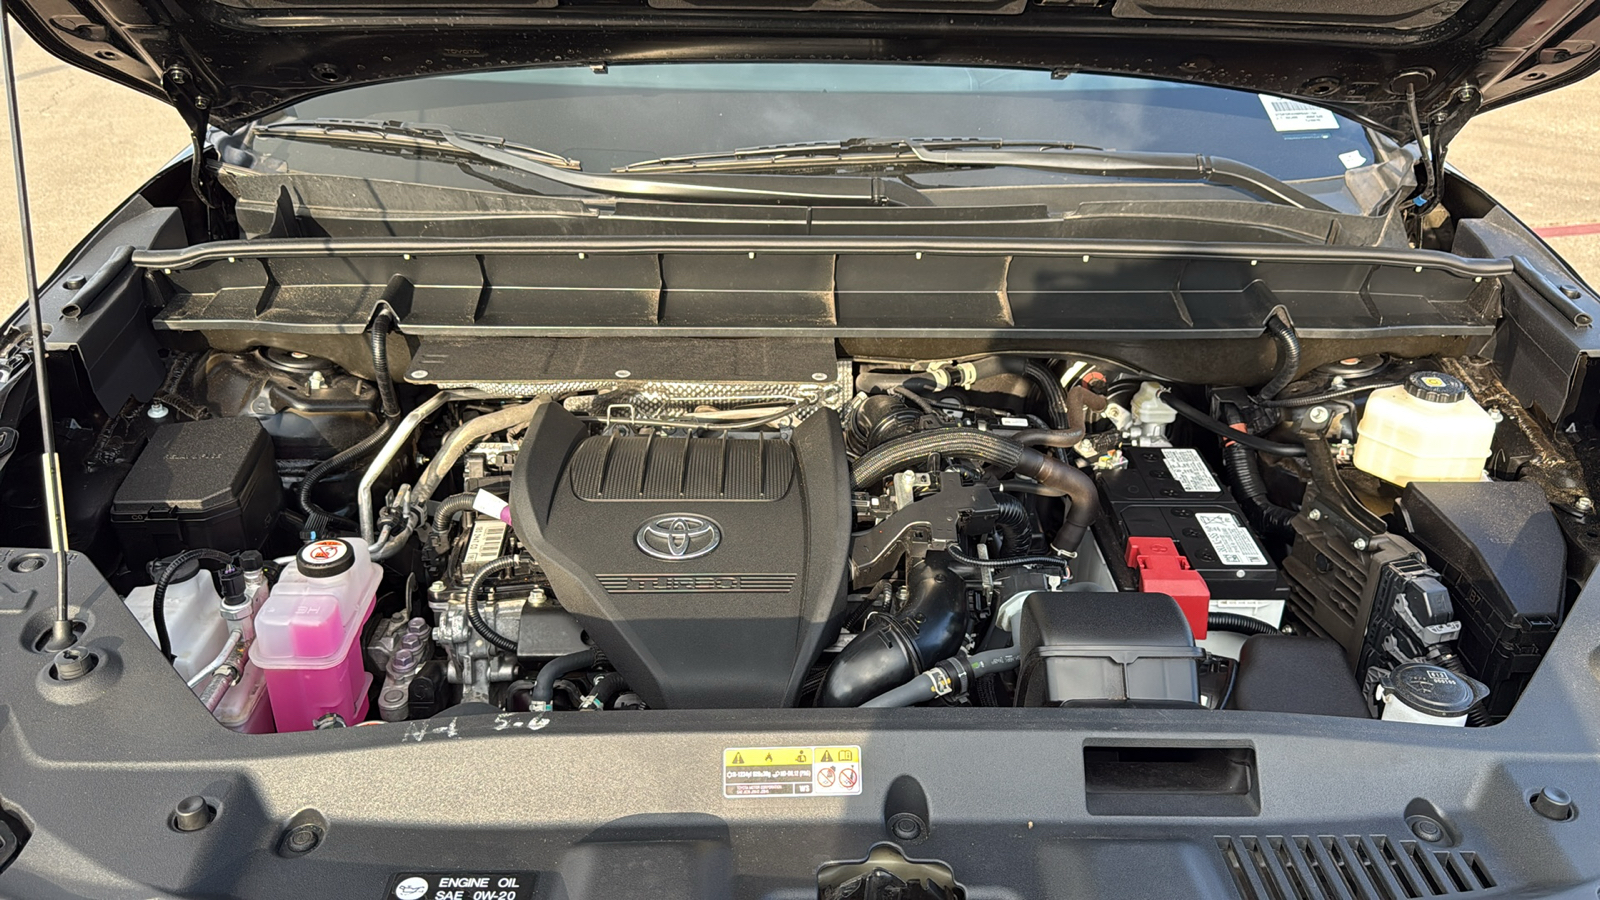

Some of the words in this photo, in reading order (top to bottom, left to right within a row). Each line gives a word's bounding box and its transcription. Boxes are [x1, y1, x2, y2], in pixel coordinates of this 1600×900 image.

[630, 577, 738, 590] TURBO
[439, 877, 490, 888] ENGINE
[498, 877, 520, 888] OIL
[435, 890, 464, 900] SAE
[473, 890, 516, 900] 0W-20
